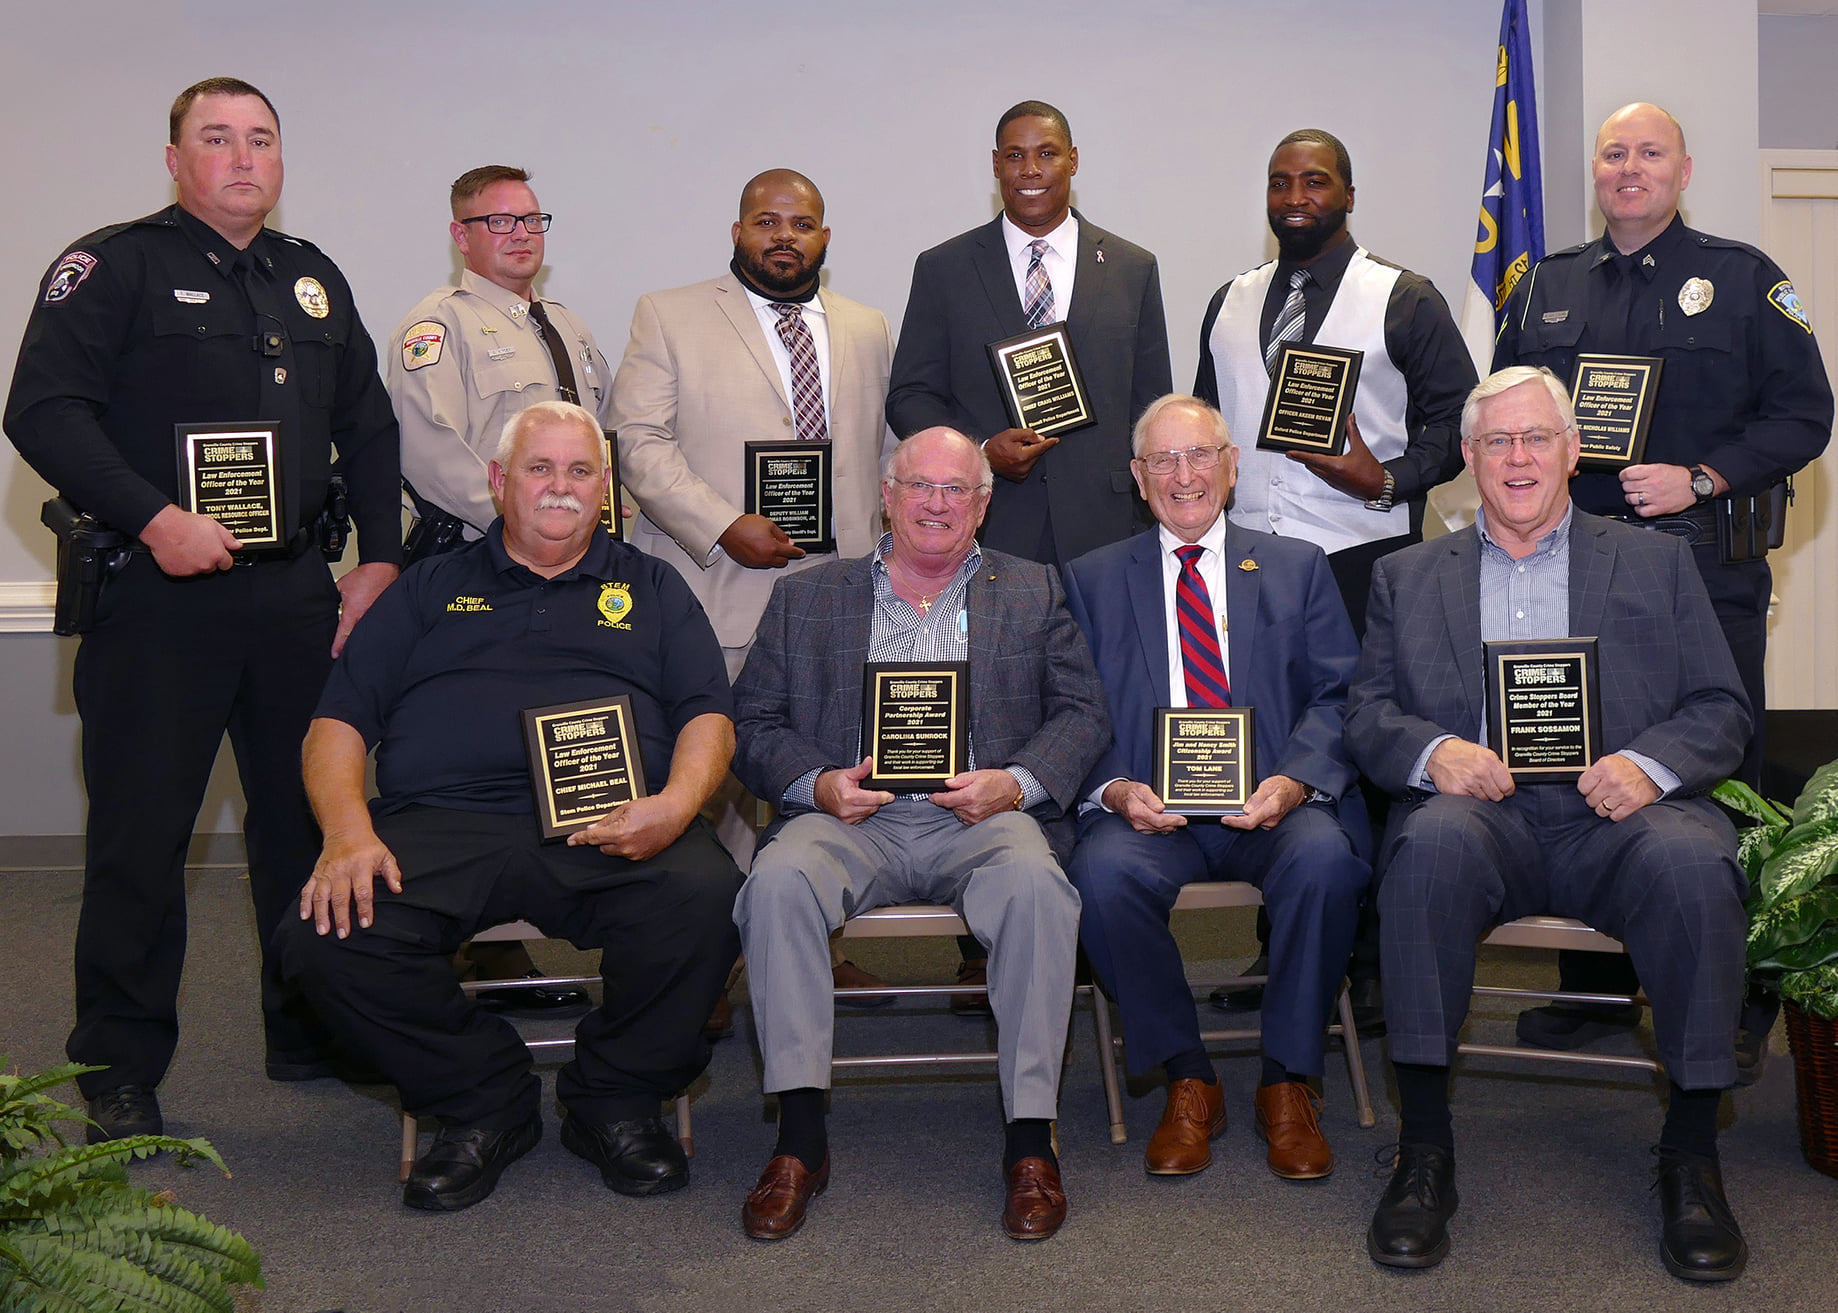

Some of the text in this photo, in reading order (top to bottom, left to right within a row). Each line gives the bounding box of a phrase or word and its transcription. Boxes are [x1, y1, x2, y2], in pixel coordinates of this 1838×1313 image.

[1013, 352, 1036, 363] CRIME
[1015, 352, 1053, 369] STOPPERS
[1295, 362, 1319, 372] CRIME
[1017, 364, 1062, 383] Law Enforcement
[1293, 368, 1332, 379] STOPPERS
[1018, 380, 1036, 390] Officer
[1037, 383, 1051, 391] 2021
[1300, 383, 1334, 393] Enforcement
[1588, 380, 1630, 389] STOPPERS
[1285, 388, 1304, 396] Officer
[1596, 395, 1633, 403] Enforcement
[1279, 409, 1298, 417] OFFICER
[203, 446, 235, 455] CRIME
[204, 452, 254, 462] STOPPERS
[219, 470, 262, 479] Enforcement
[768, 468, 807, 476] STOPPERS
[201, 480, 226, 488] Officer
[206, 504, 226, 512] TONY
[600, 582, 630, 590] STEM
[455, 596, 485, 604] CHIEF
[447, 603, 465, 612] M.D.
[597, 620, 632, 630] POLICE
[1514, 668, 1547, 677] CRIME
[1515, 675, 1566, 684] STOPPERS
[890, 684, 920, 692] CRIME
[553, 723, 586, 734] CRIME
[1511, 725, 1581, 734] FRANK SOSSAMON
[555, 727, 606, 742] STOPPERS
[554, 743, 616, 759] Law Enforcement
[554, 758, 580, 768] Officer
[581, 756, 589, 764] of
[603, 752, 620, 760] Year
[580, 763, 598, 772] 2021
[555, 778, 628, 795] CHIEF MICHAEL BEAL
